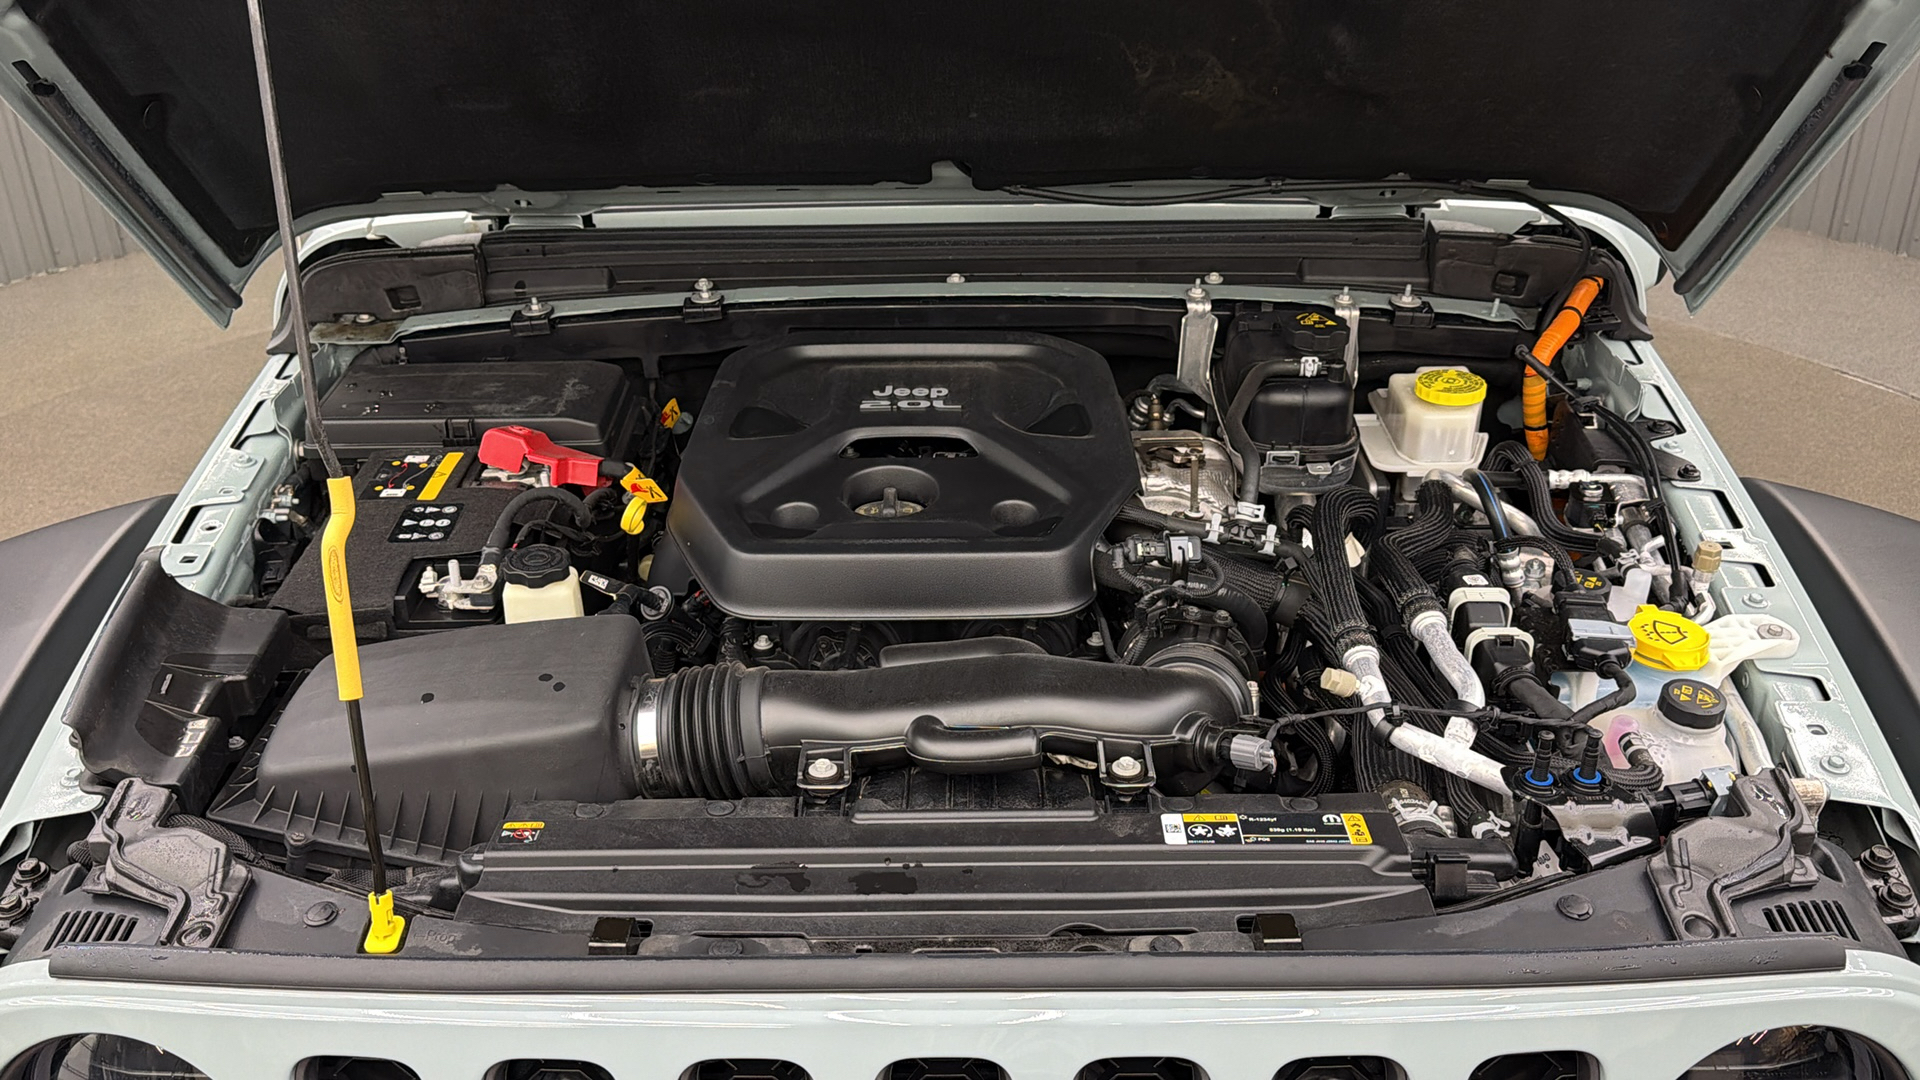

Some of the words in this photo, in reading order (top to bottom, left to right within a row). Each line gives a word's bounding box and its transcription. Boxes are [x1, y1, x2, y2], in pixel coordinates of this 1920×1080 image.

[872, 385, 949, 398] Jeep
[860, 400, 962, 411] 2.0L
[426, 929, 456, 945] Prop
